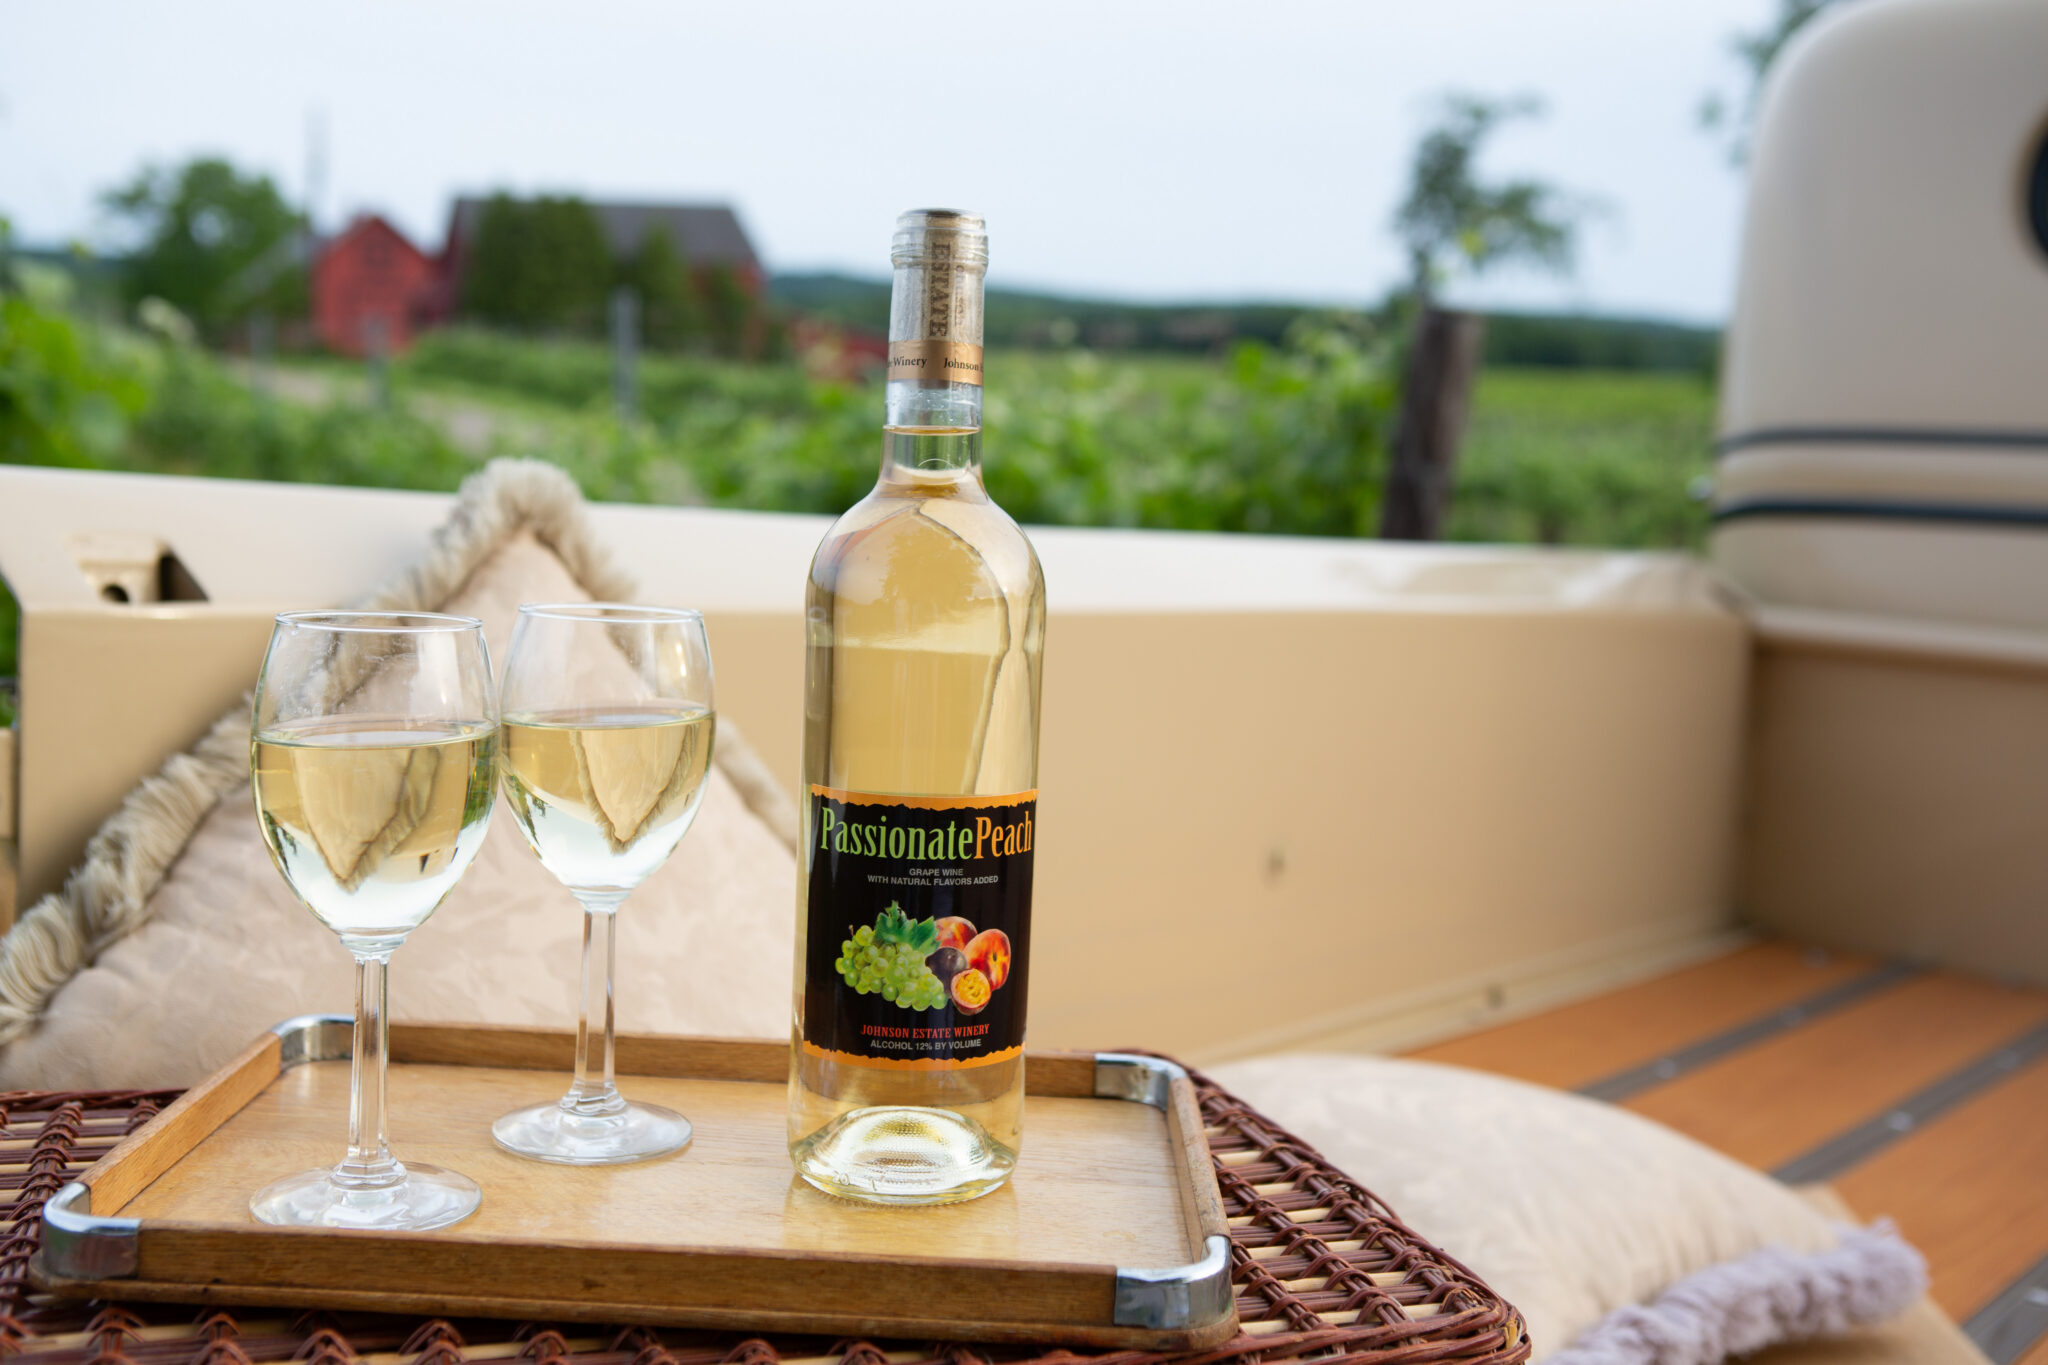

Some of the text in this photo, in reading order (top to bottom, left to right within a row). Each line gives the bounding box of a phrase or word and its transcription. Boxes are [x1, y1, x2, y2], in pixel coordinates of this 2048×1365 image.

[928, 242, 951, 337] ESTATE
[893, 356, 928, 369] Winery
[943, 357, 980, 371] Johnson
[909, 868, 964, 876] GRAPE WINE
[867, 874, 999, 886] WITH NATURAL FLAVORS ADDED
[861, 1023, 990, 1039] JOHNSON ESTATE WINERY
[870, 1039, 982, 1051] ALCOHOL 12% BY VOLUME
